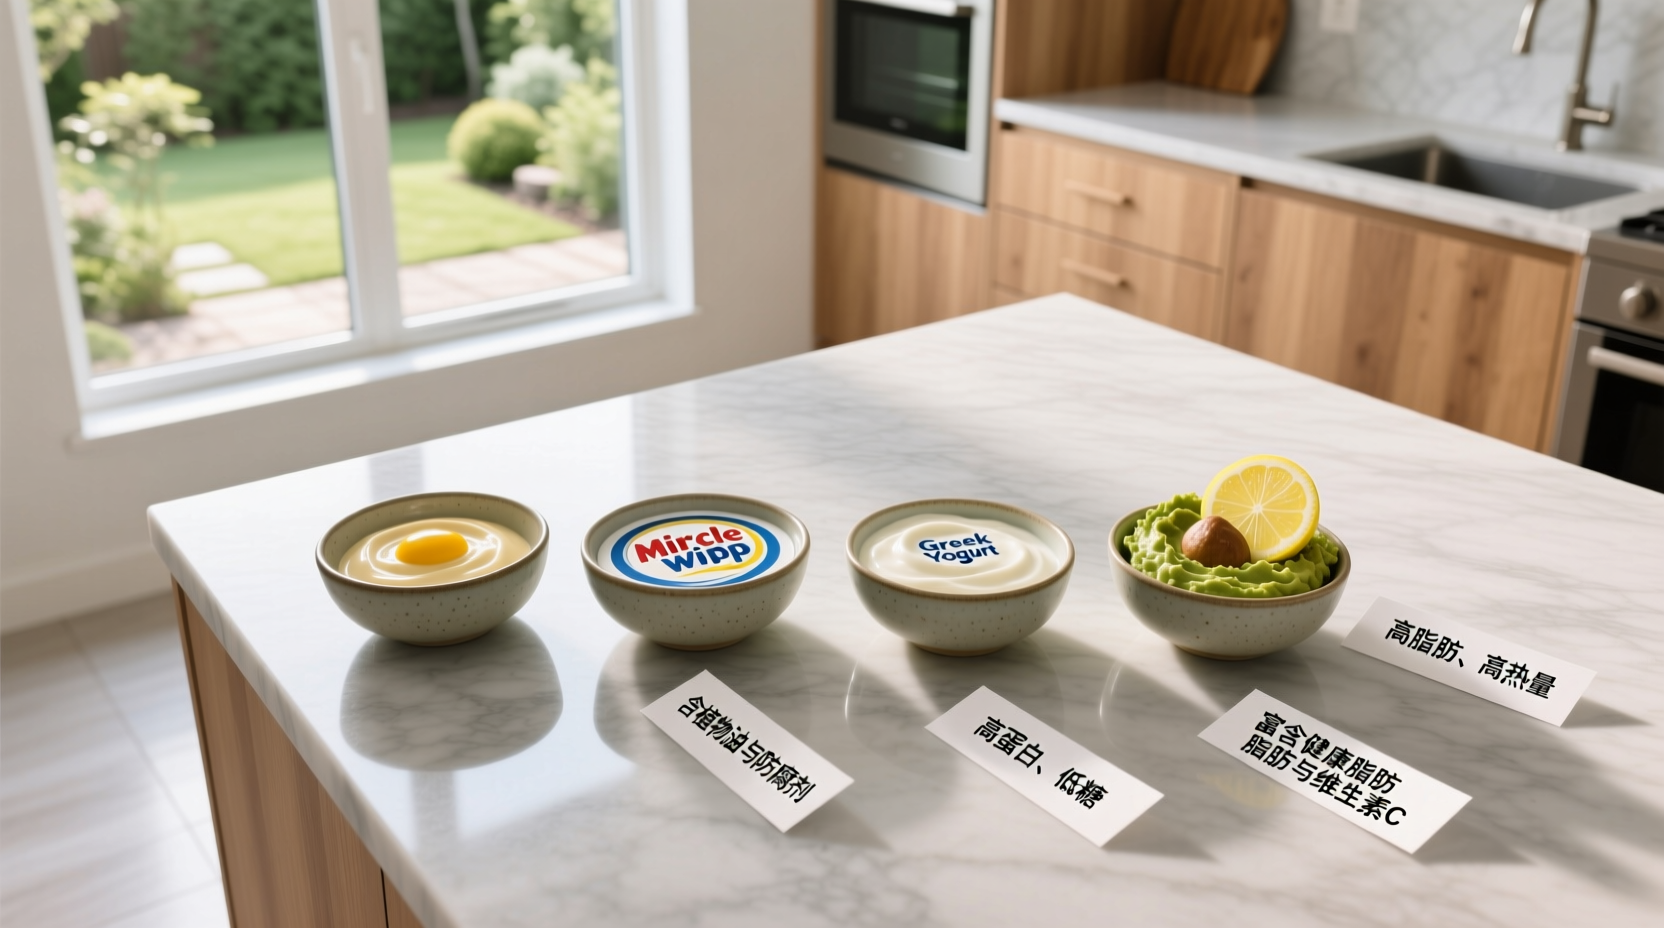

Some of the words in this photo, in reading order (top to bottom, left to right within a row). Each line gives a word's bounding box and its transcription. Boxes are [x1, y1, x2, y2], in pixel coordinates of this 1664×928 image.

[634, 526, 743, 563] Mircle
[918, 532, 993, 551] Greek
[923, 545, 1000, 564] Yogurt
[1385, 619, 1557, 699] 高脂肪、高热量
[1240, 733, 1407, 826] 脂肪与维生素C
